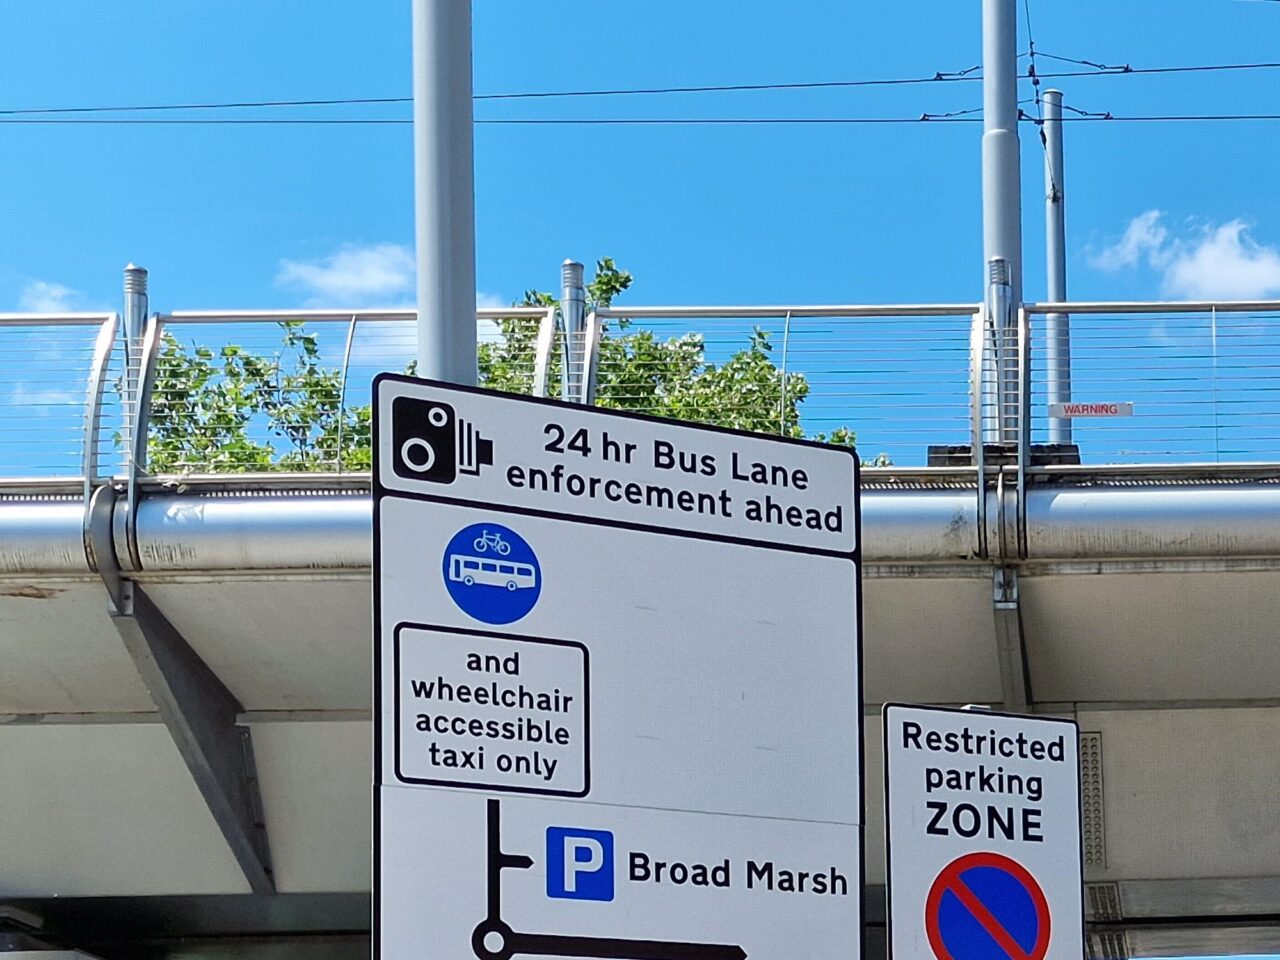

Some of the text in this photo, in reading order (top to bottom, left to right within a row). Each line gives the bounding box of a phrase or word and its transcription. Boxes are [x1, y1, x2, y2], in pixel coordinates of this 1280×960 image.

[1064, 404, 1118, 414] WARNING
[543, 423, 809, 490] 24 hr Bus Lane
[506, 465, 843, 533] enforcement ahead
[466, 651, 520, 675] and
[411, 678, 573, 713] wheelchair
[415, 710, 570, 745] accessible
[902, 721, 1065, 762] Restricted
[429, 743, 558, 780] taxi only
[926, 764, 1042, 801] parking
[926, 802, 1043, 841] ZONE
[628, 852, 731, 888] Broad
[746, 861, 848, 895] Marsh
